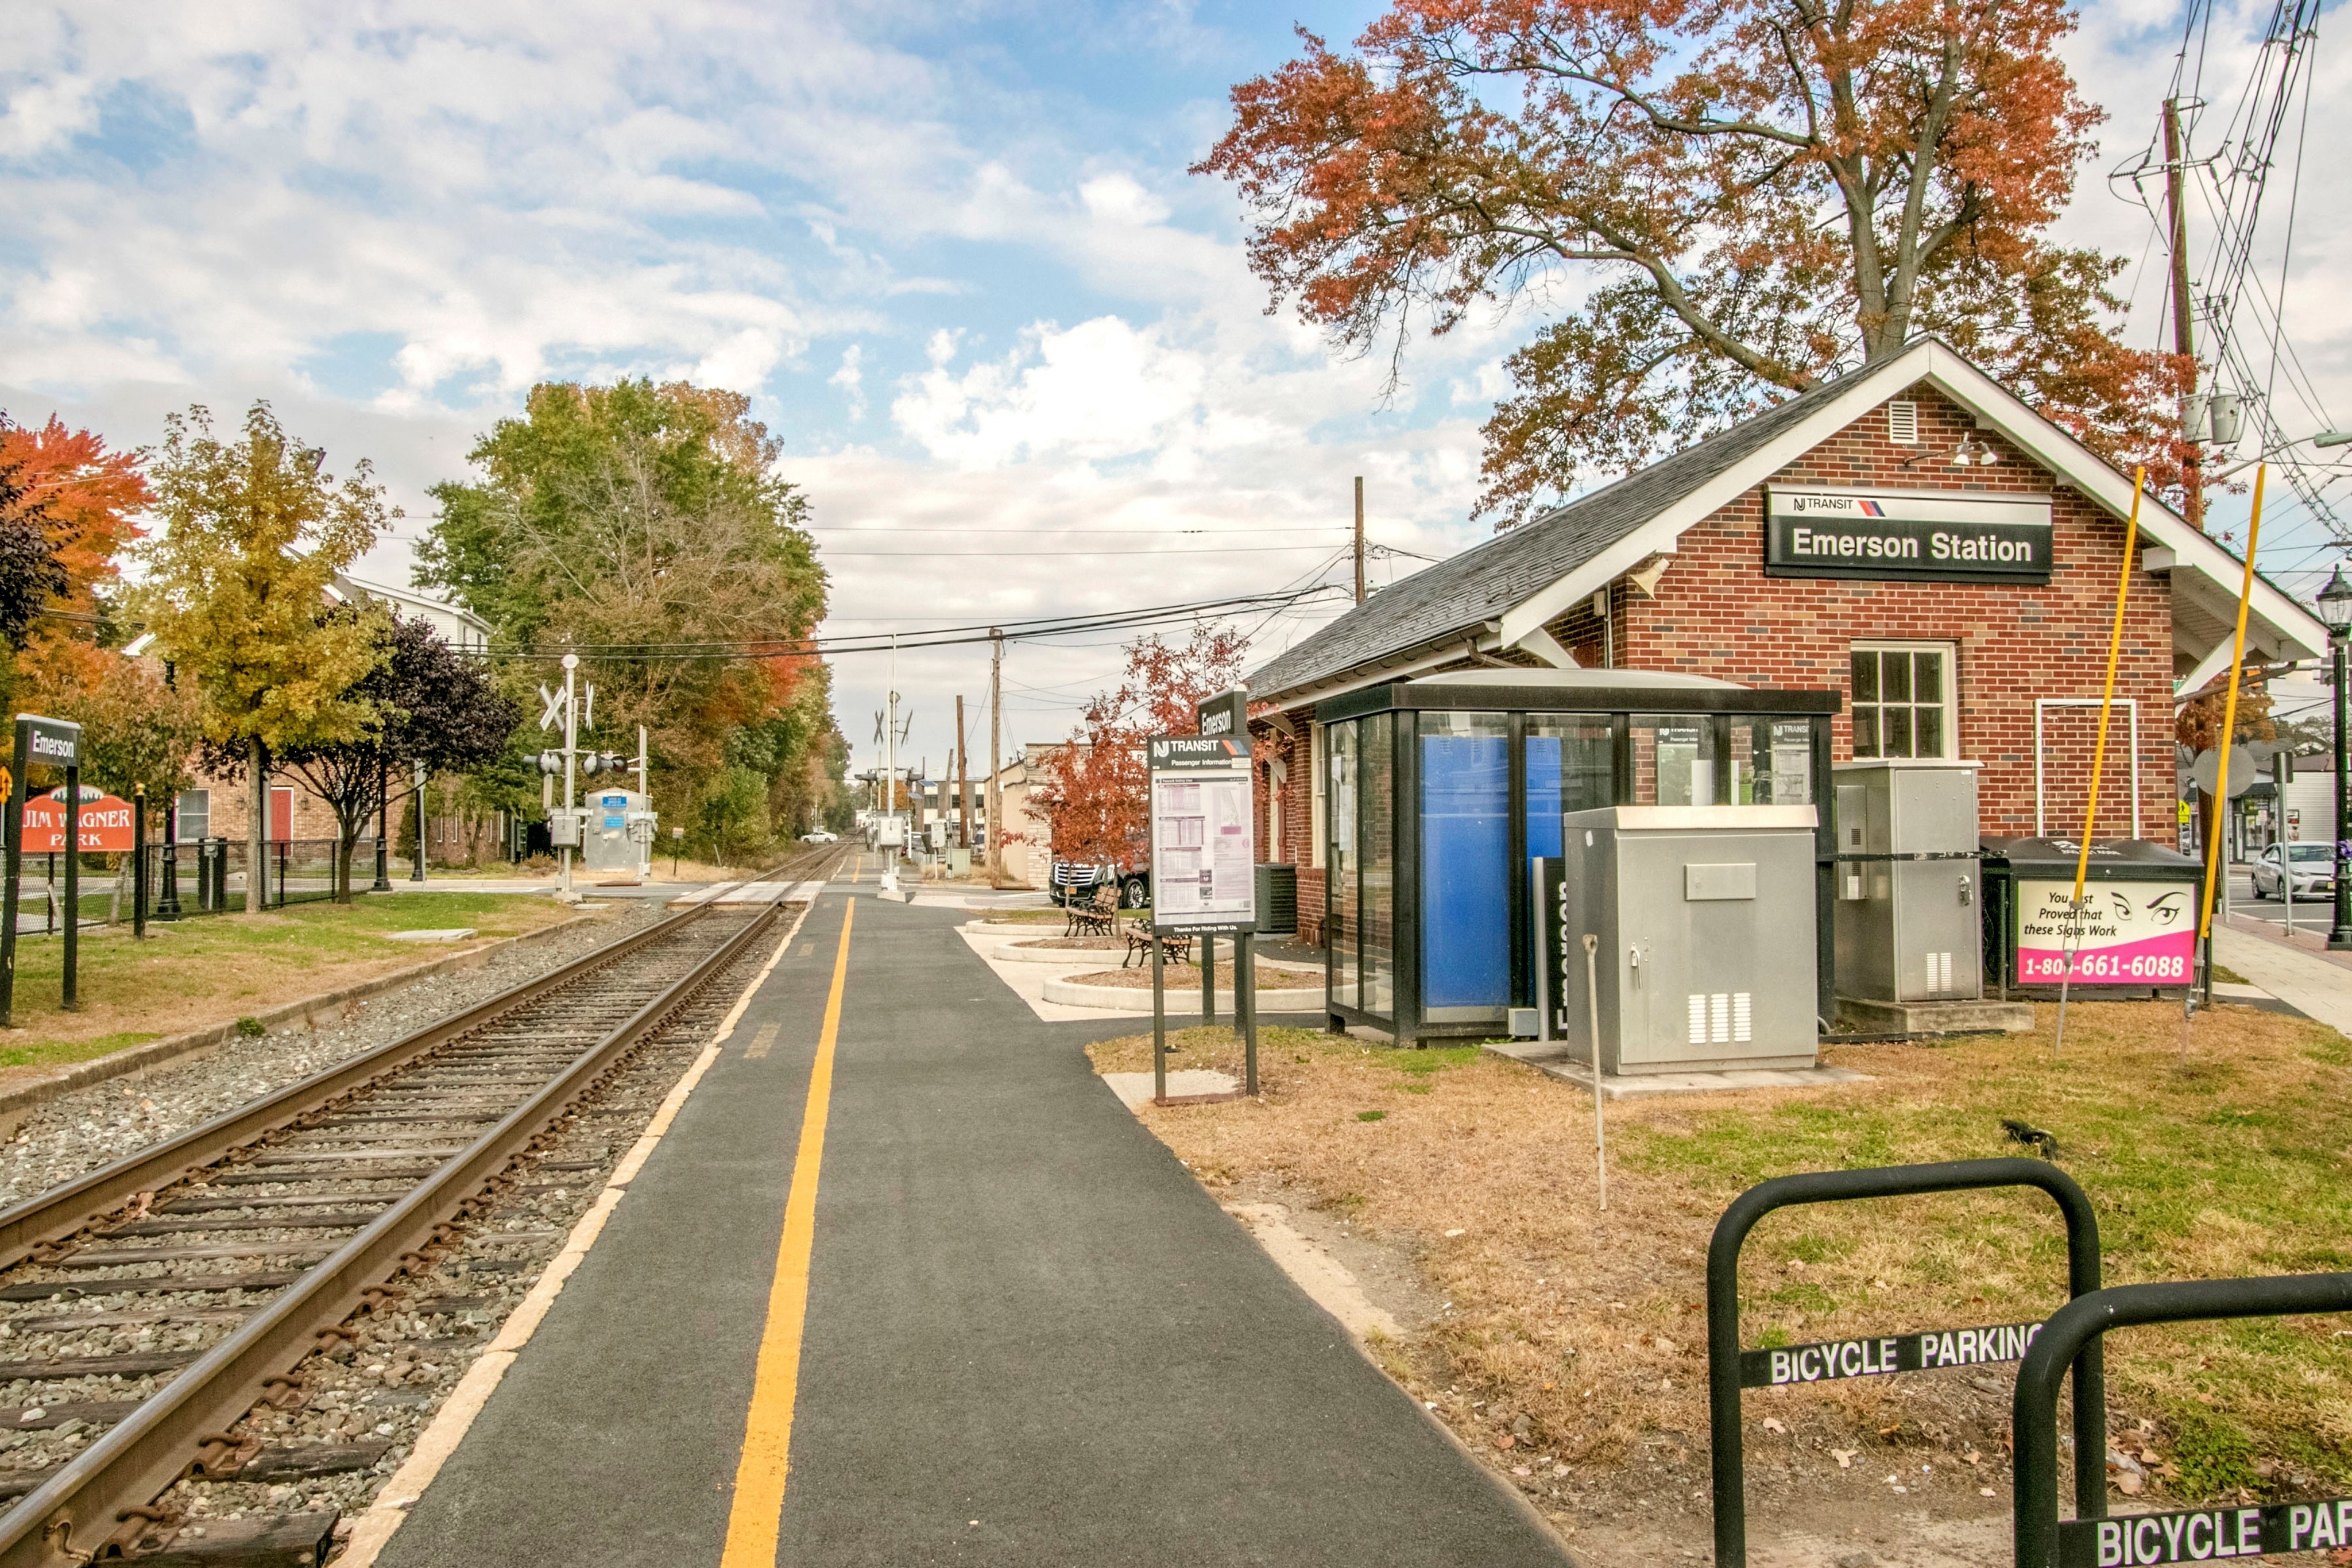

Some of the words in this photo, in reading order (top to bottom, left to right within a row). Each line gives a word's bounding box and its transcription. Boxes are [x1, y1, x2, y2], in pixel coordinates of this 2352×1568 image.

[1793, 498, 1806, 511] NJ
[1807, 498, 1854, 510] TRANSIT
[1793, 528, 1920, 558] Emerson
[1931, 532, 2033, 562] Station
[1201, 710, 1231, 735] Emerson
[32, 730, 75, 758] Emerson
[1154, 741, 1170, 758] NJ
[1170, 740, 1219, 752] TRANSIT
[22, 810, 52, 828] JIM
[2049, 892, 2069, 904] You
[2038, 908, 2077, 920] Proved
[2079, 908, 2103, 920] that
[2024, 923, 2054, 935] these
[2056, 924, 2086, 938] Signs
[2089, 925, 2118, 936] Work
[1771, 1338, 1898, 1384] BICYCLE
[2097, 1508, 2262, 1567] BICYCLE
